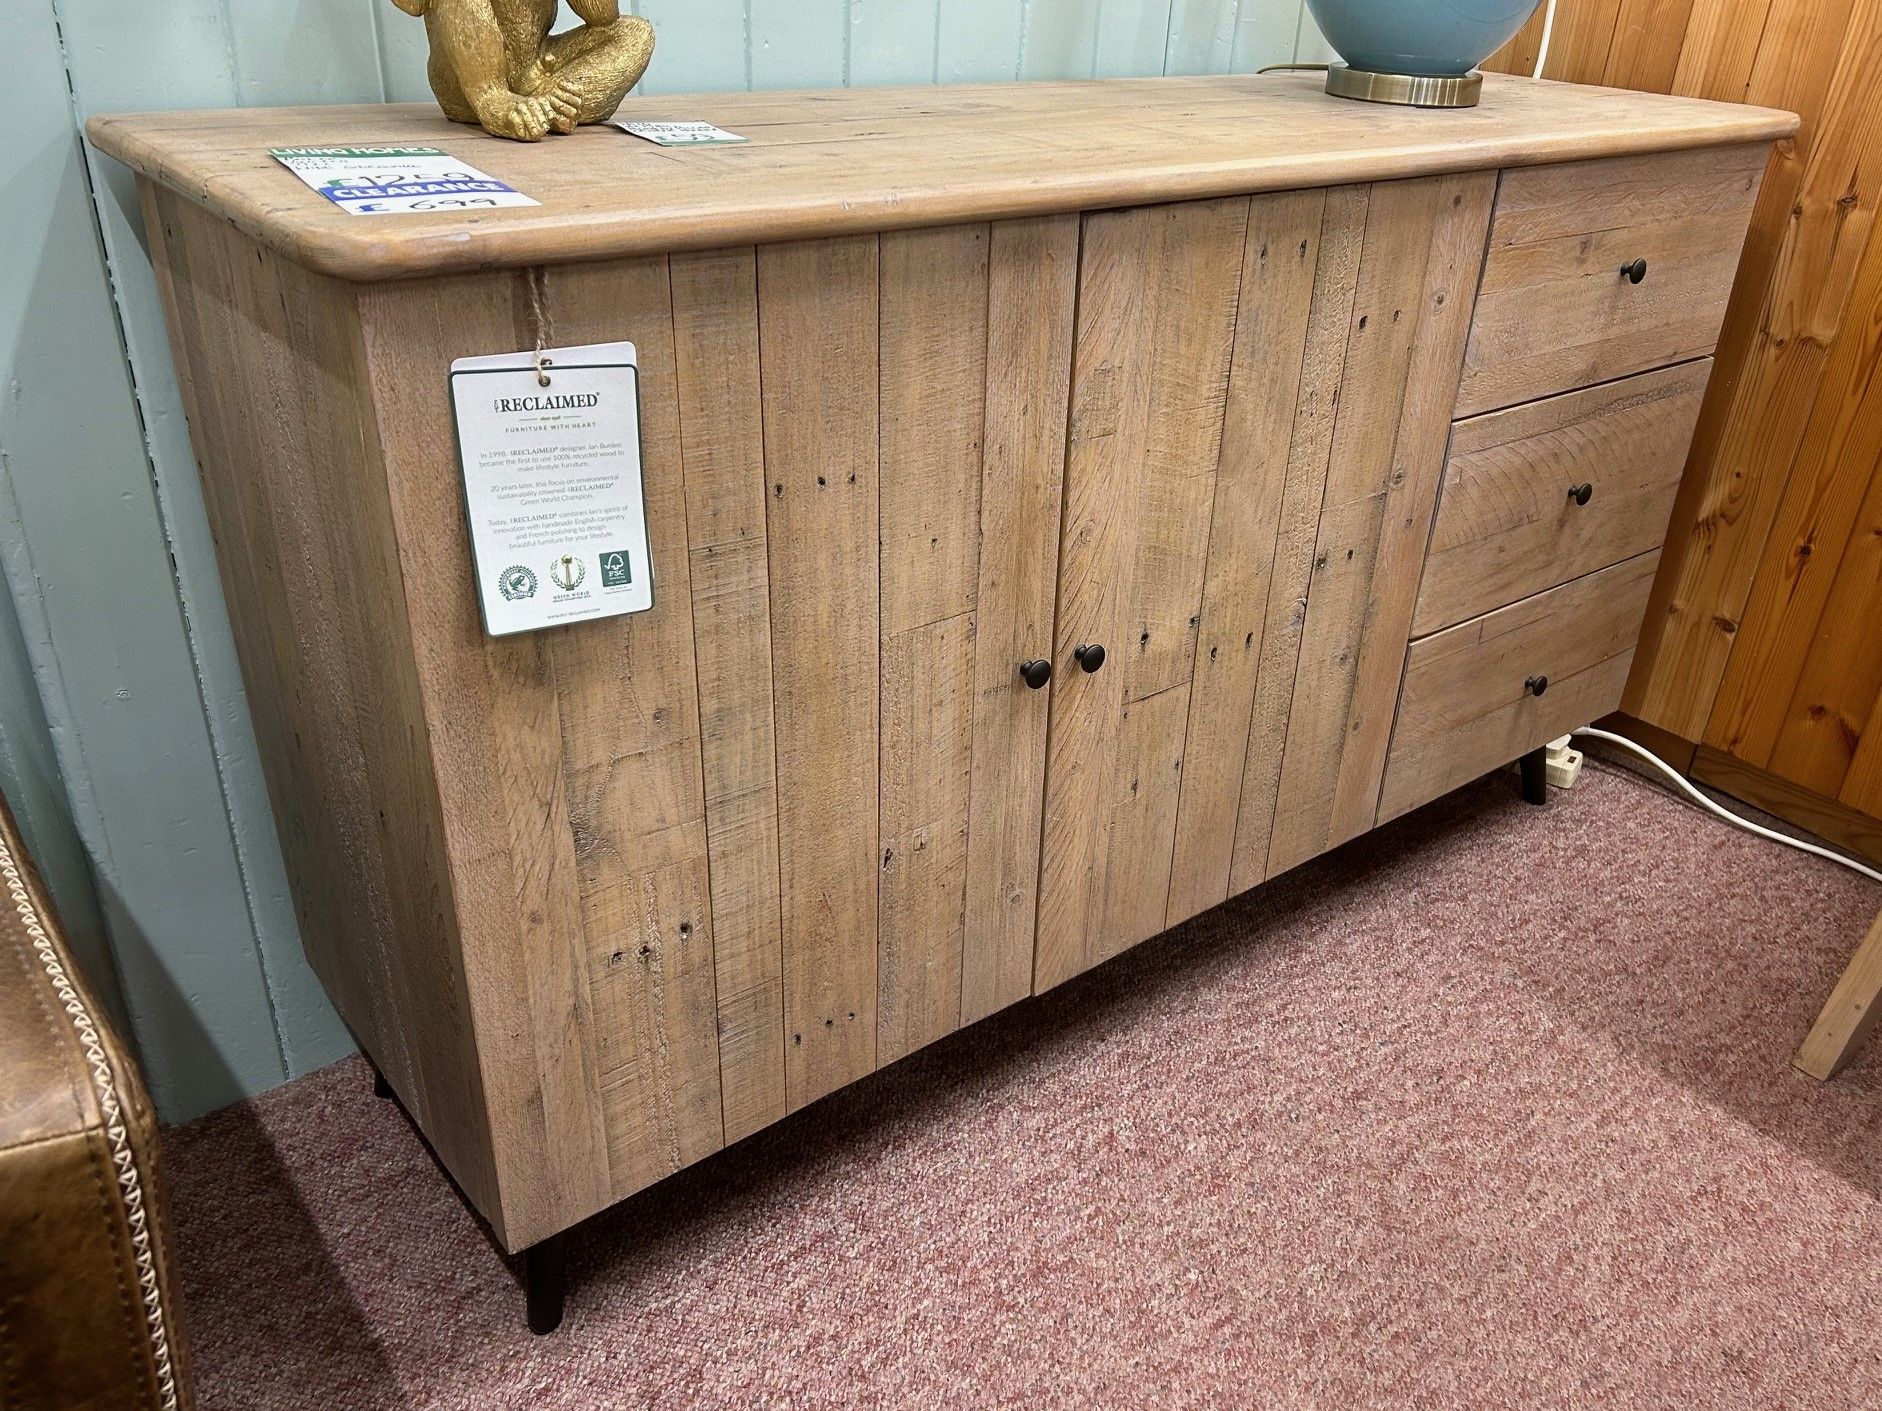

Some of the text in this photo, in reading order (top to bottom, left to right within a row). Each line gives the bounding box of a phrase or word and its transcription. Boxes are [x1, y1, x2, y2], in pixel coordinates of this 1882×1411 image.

[333, 182, 505, 199] CLEARANCE
[409, 198, 498, 210] 699
[505, 421, 597, 433] FURNITURE WITH HEART
[478, 460, 504, 468] became
[572, 451, 599, 461] recycled
[599, 449, 617, 457] wood
[517, 464, 534, 472] make
[500, 483, 518, 491] years
[576, 474, 619, 483] environmental
[497, 490, 537, 500] sustainability
[538, 487, 566, 495] crowned
[520, 497, 540, 506] Green
[541, 495, 560, 503] World
[559, 508, 588, 518] combines
[621, 504, 629, 512] of
[493, 525, 526, 534] innovation
[541, 518, 574, 529] handmade
[574, 516, 596, 527] English
[596, 513, 626, 523] carpentry
[515, 531, 527, 540] and
[528, 528, 550, 538] French
[550, 525, 578, 537] polishing
[586, 522, 607, 533] design
[509, 539, 537, 549] beautiful
[537, 537, 564, 547] furniture
[564, 535, 574, 543] for
[575, 534, 589, 543] your
[608, 569, 625, 578] FSC
